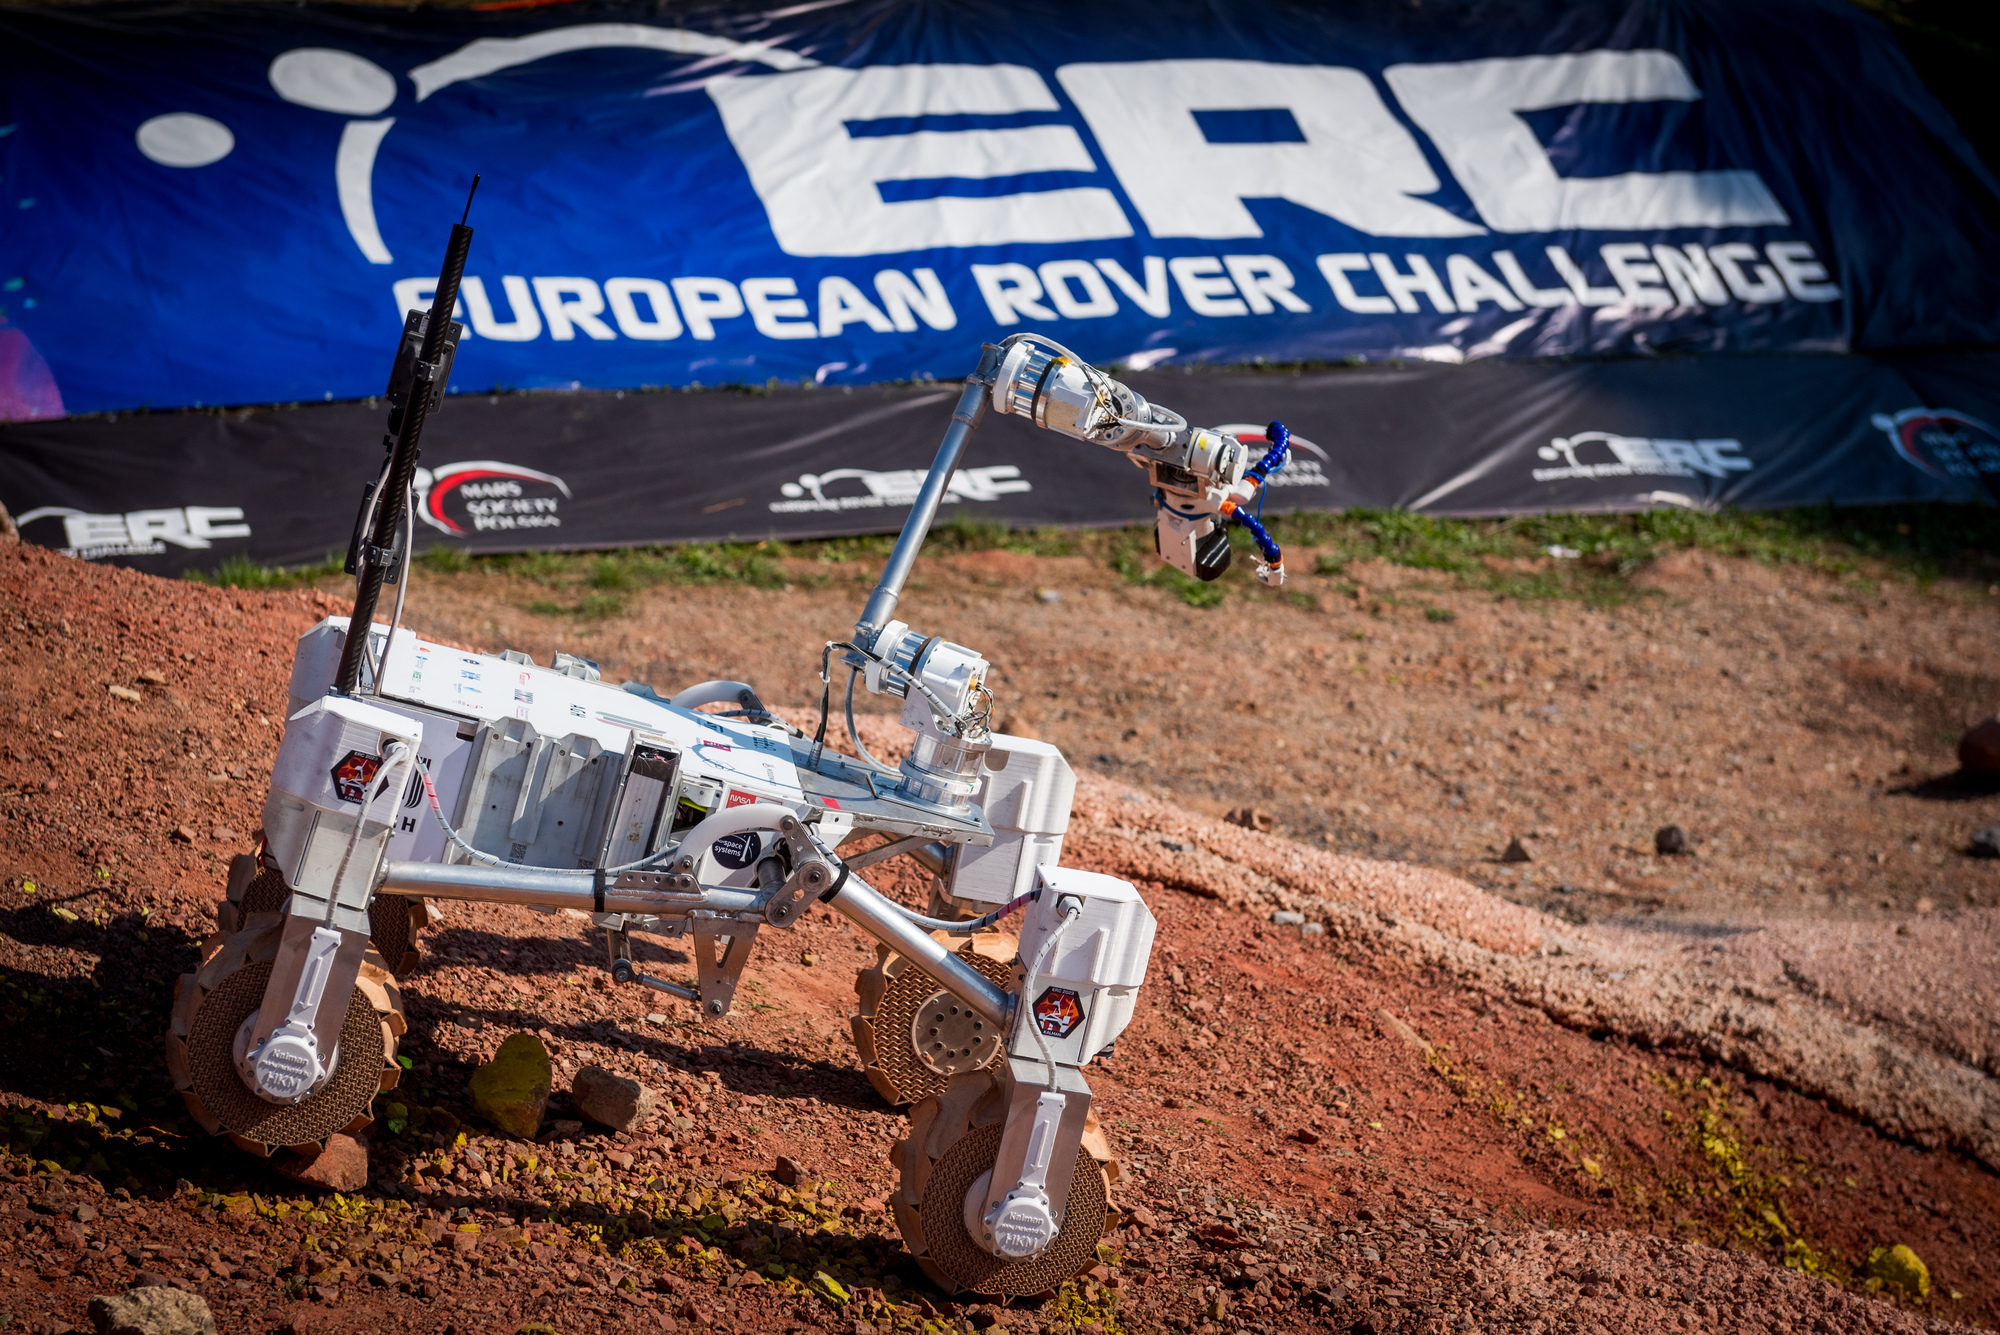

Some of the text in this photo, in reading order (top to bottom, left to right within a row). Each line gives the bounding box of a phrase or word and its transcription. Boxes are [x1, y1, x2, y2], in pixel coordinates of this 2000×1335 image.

[706, 48, 1791, 258] ERC
[393, 241, 1842, 342] EUROPEAN ROVER CHALLENGE
[1606, 436, 1754, 478] ERC
[459, 480, 522, 499] MARS
[466, 497, 558, 516] SOCIETY
[63, 505, 252, 549] ERC
[730, 794, 751, 805] NASA
[714, 845, 741, 857] systems
[723, 840, 743, 850] space
